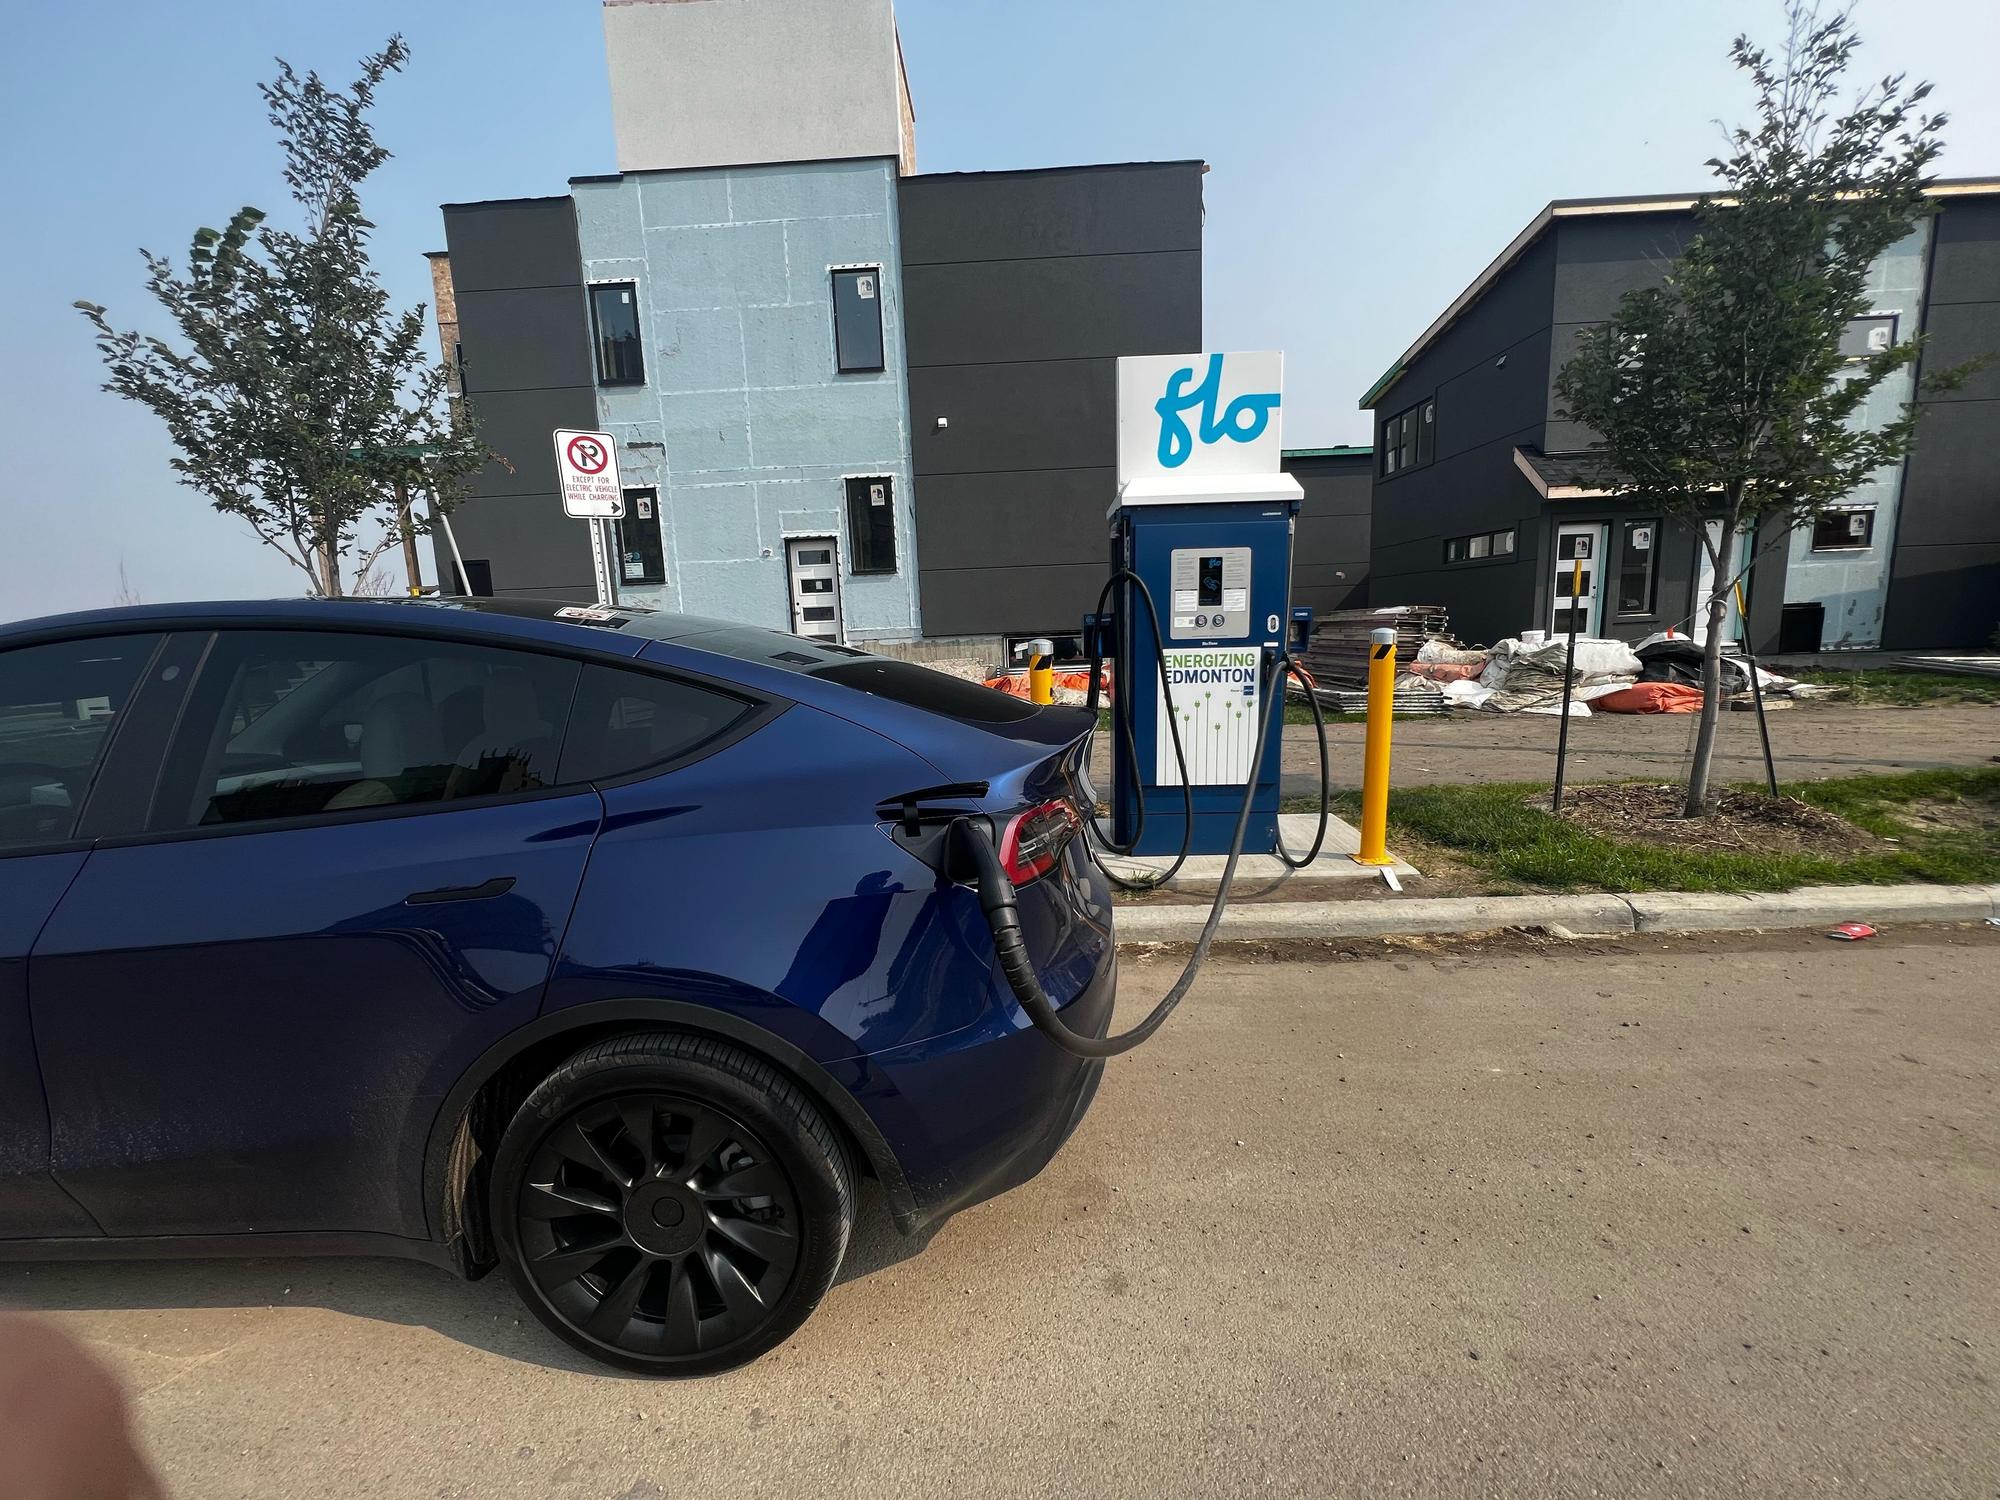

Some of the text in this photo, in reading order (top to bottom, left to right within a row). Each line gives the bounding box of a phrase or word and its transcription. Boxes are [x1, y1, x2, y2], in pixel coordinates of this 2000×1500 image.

[1155, 354, 1281, 468] flo
[572, 476, 610, 485] EXCEPT FOR
[566, 484, 618, 493] ELECTRIC VEHICLE
[568, 493, 618, 502] WHILE CHARGING
[1164, 653, 1255, 669] ENERGIZING
[1165, 669, 1255, 684] EDMONTON
